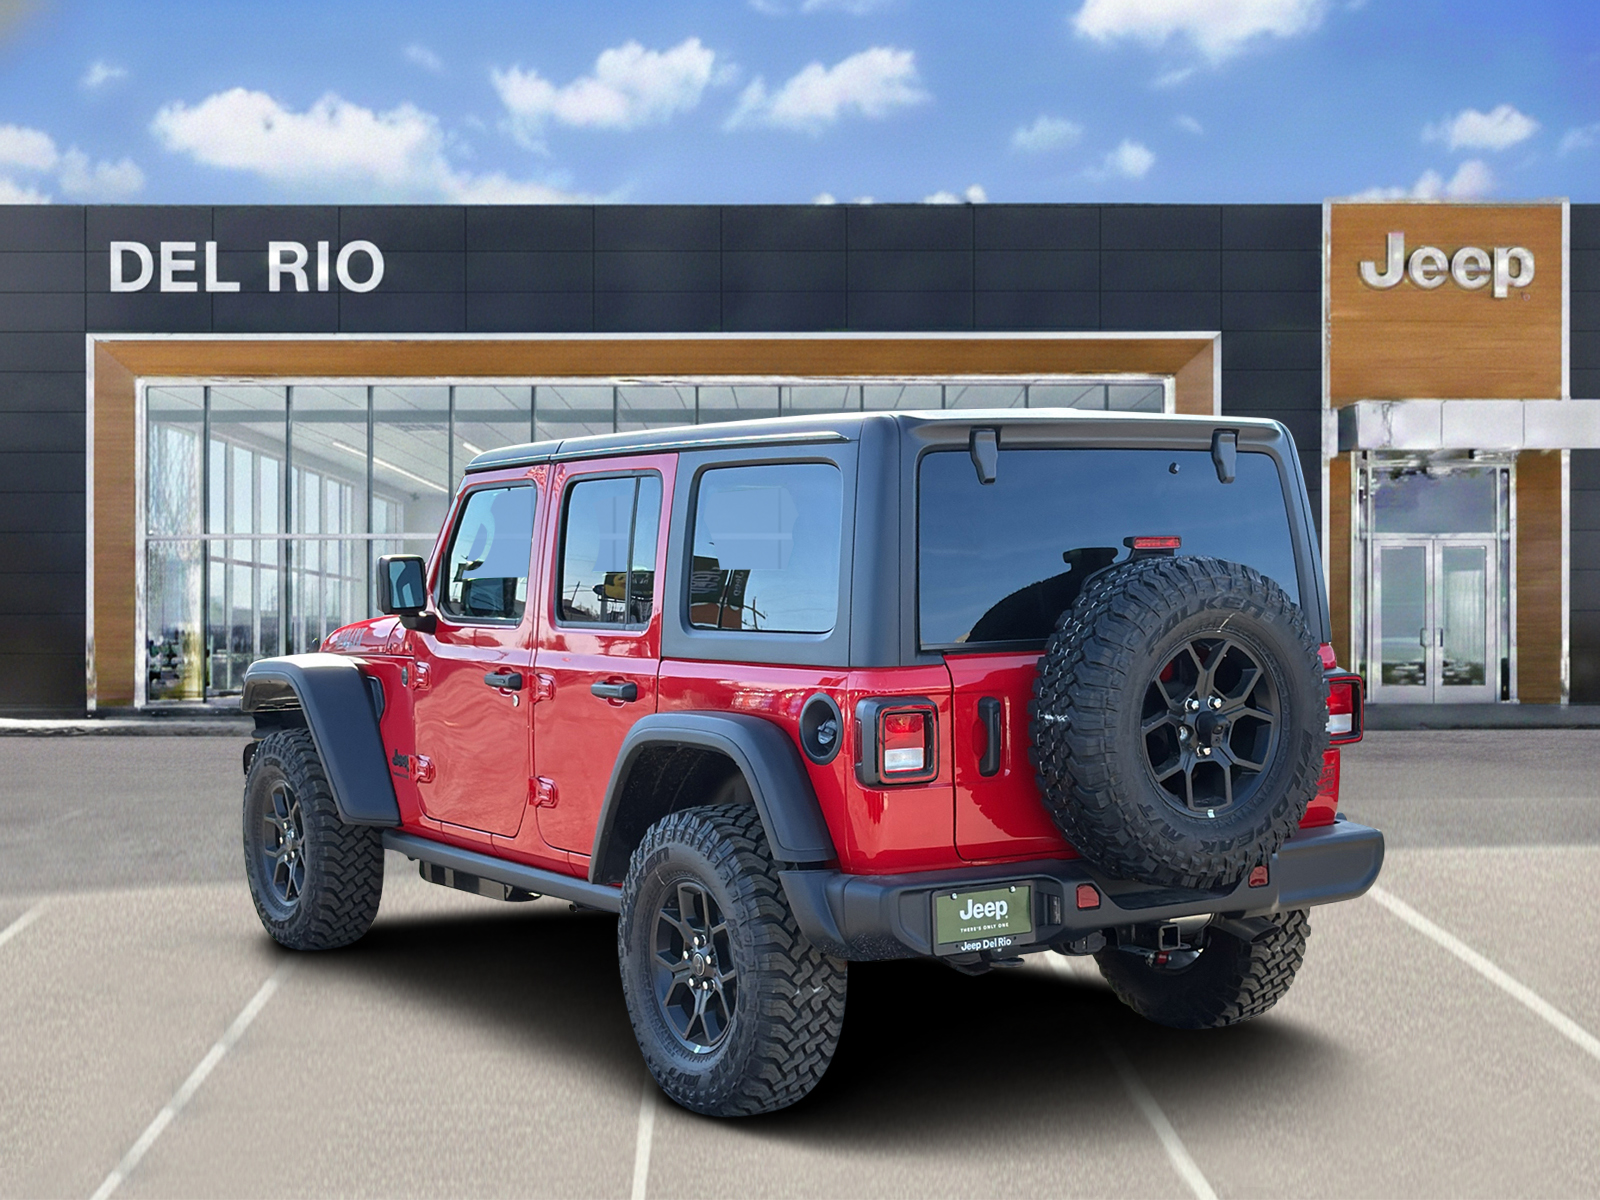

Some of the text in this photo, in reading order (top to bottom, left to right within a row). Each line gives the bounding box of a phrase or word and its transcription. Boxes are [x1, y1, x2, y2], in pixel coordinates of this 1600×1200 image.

[110, 240, 384, 292] DEL RIO
[1360, 231, 1535, 299] Jeep
[959, 899, 1008, 921] Jeep
[961, 936, 1012, 950] Jeep Del Rio
